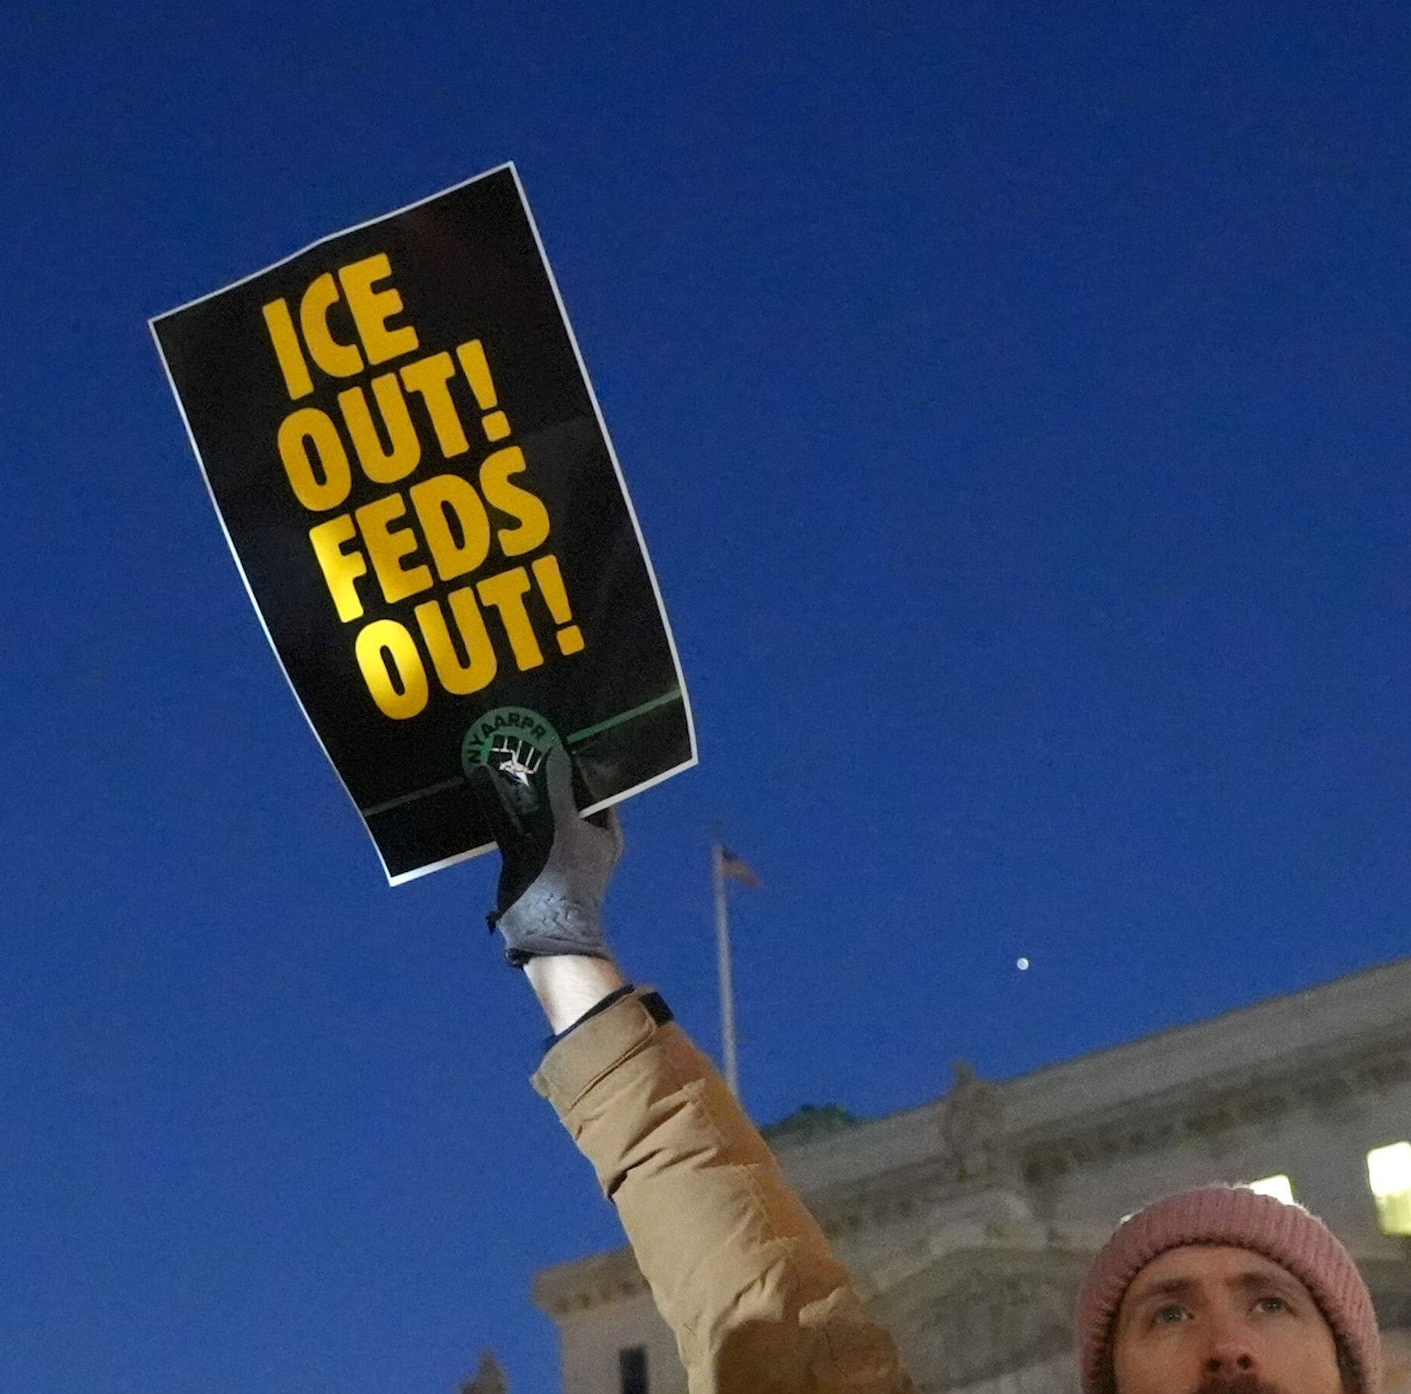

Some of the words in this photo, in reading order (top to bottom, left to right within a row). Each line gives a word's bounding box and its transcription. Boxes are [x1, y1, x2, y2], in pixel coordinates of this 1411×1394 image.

[262, 251, 420, 402] ICE
[276, 338, 513, 513] OUT!
[307, 444, 552, 624] FEDS
[354, 554, 586, 721] OUT!
[467, 712, 548, 764] NYAARPR
